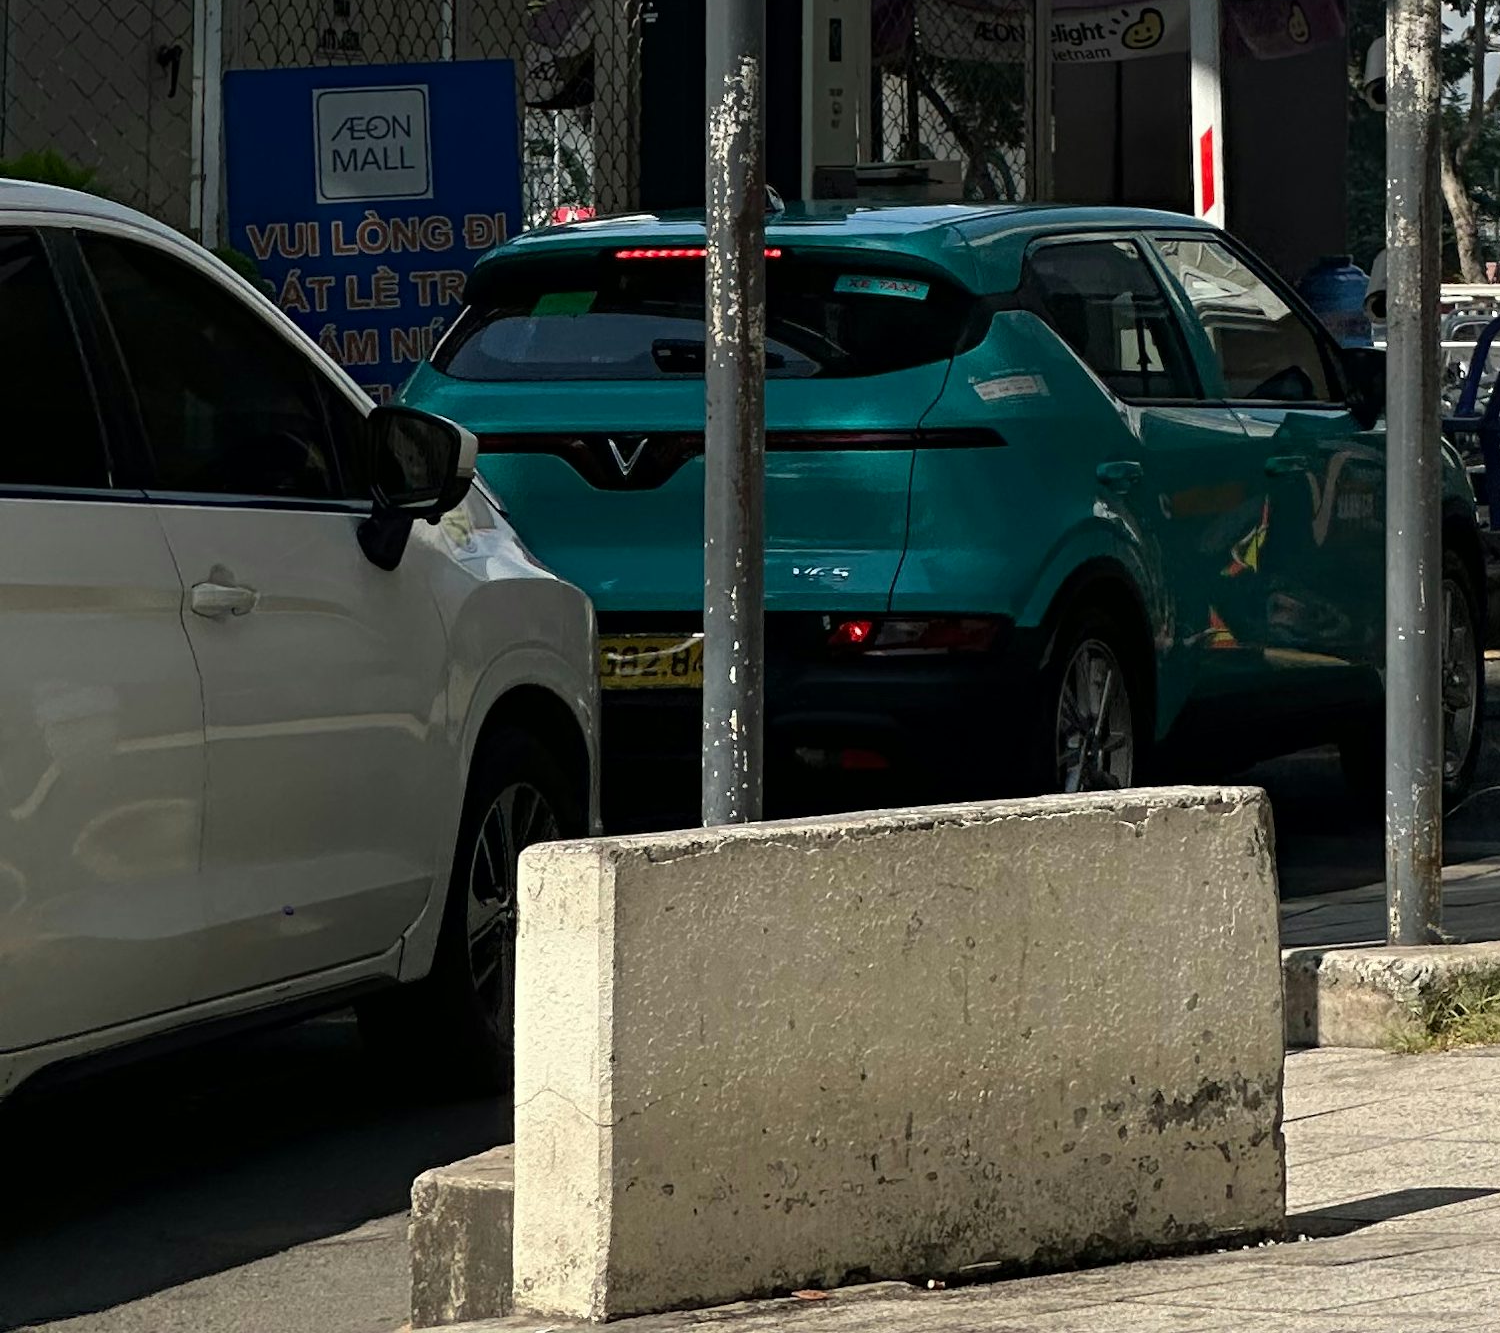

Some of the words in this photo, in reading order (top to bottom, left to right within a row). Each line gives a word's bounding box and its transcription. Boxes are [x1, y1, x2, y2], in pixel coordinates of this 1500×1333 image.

[1051, 22, 1106, 46] elight
[1052, 47, 1112, 62] ietnam
[332, 145, 415, 174] MALL
[245, 220, 321, 261] VUI
[331, 210, 455, 258] LÒNG
[462, 213, 509, 251] ĐI
